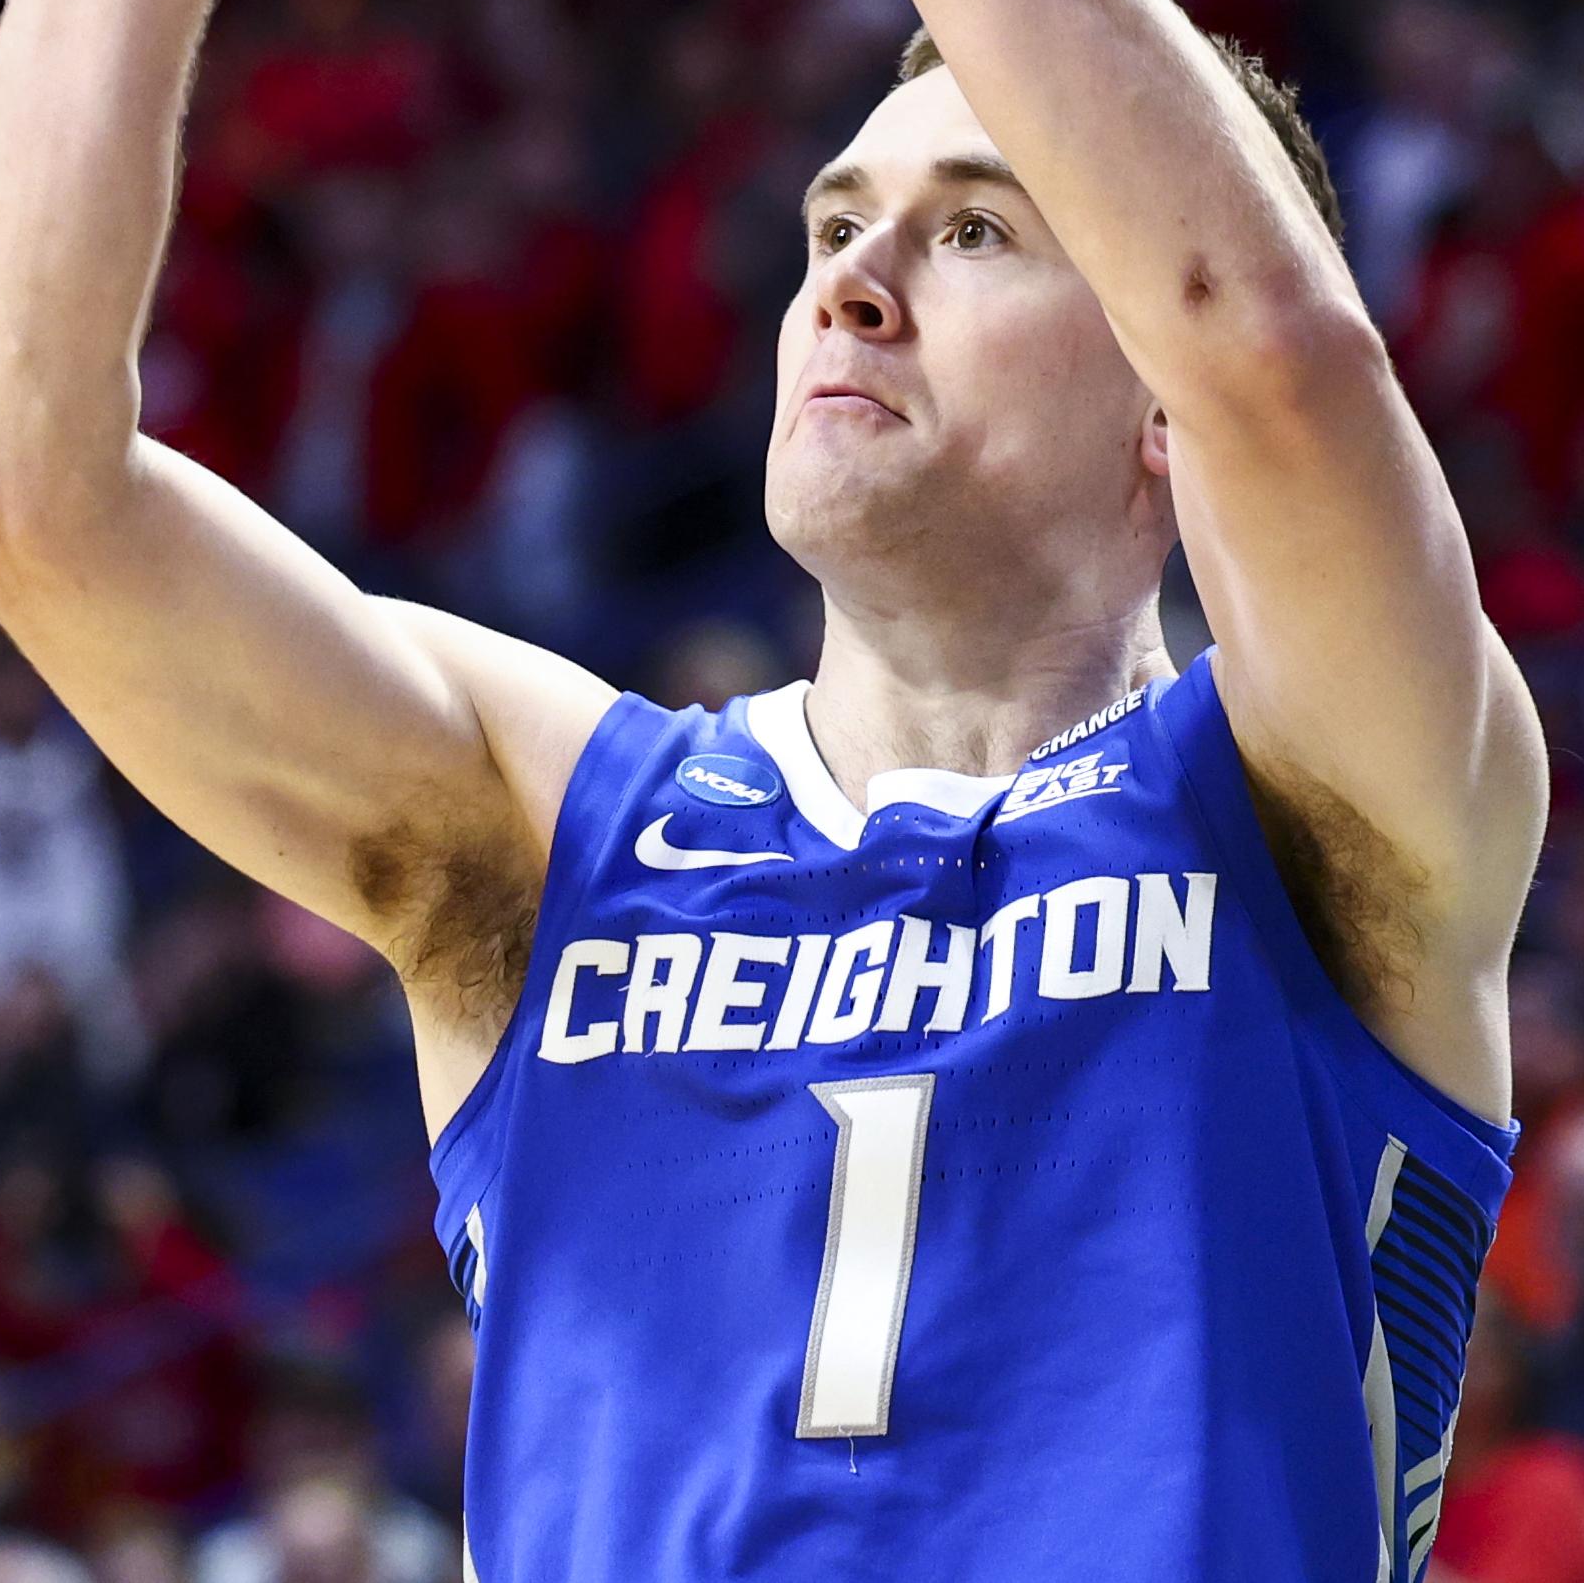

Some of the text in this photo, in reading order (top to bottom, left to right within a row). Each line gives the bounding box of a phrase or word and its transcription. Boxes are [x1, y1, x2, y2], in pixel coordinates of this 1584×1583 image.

[1029, 687, 1145, 762] CHANGE
[684, 766, 768, 803] NCAA
[1000, 763, 1129, 813] EAST
[1013, 750, 1105, 793] BIG
[537, 871, 1217, 1065] CREIGHTON
[794, 1072, 936, 1438] 1
